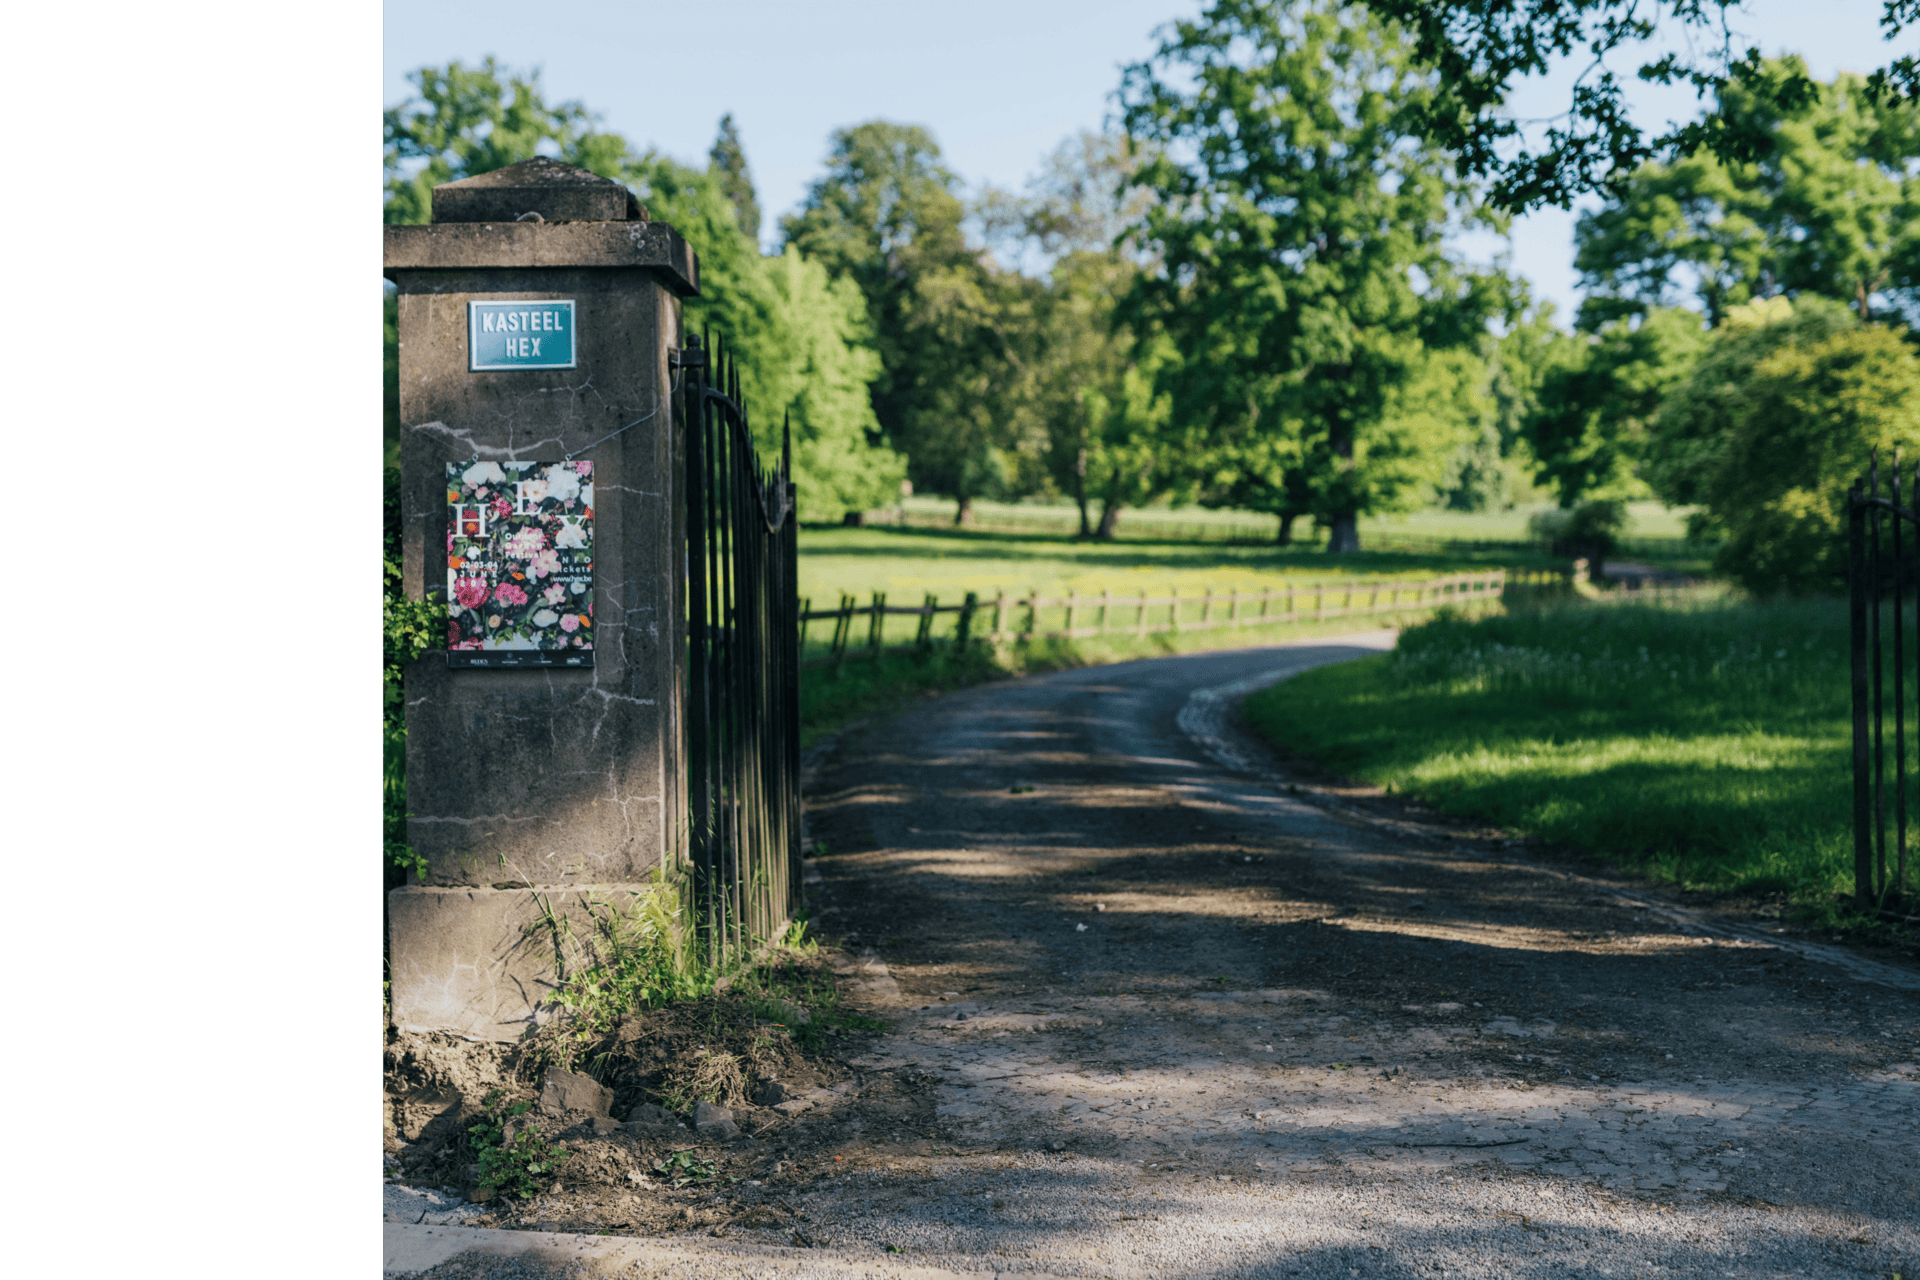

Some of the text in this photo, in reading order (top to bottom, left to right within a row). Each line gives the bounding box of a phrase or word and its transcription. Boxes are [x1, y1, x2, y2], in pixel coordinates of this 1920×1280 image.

[482, 311, 563, 332] KASTEEL
[505, 337, 541, 357] HEX
[460, 570, 498, 578] JUNE
[460, 579, 498, 588] 2023
